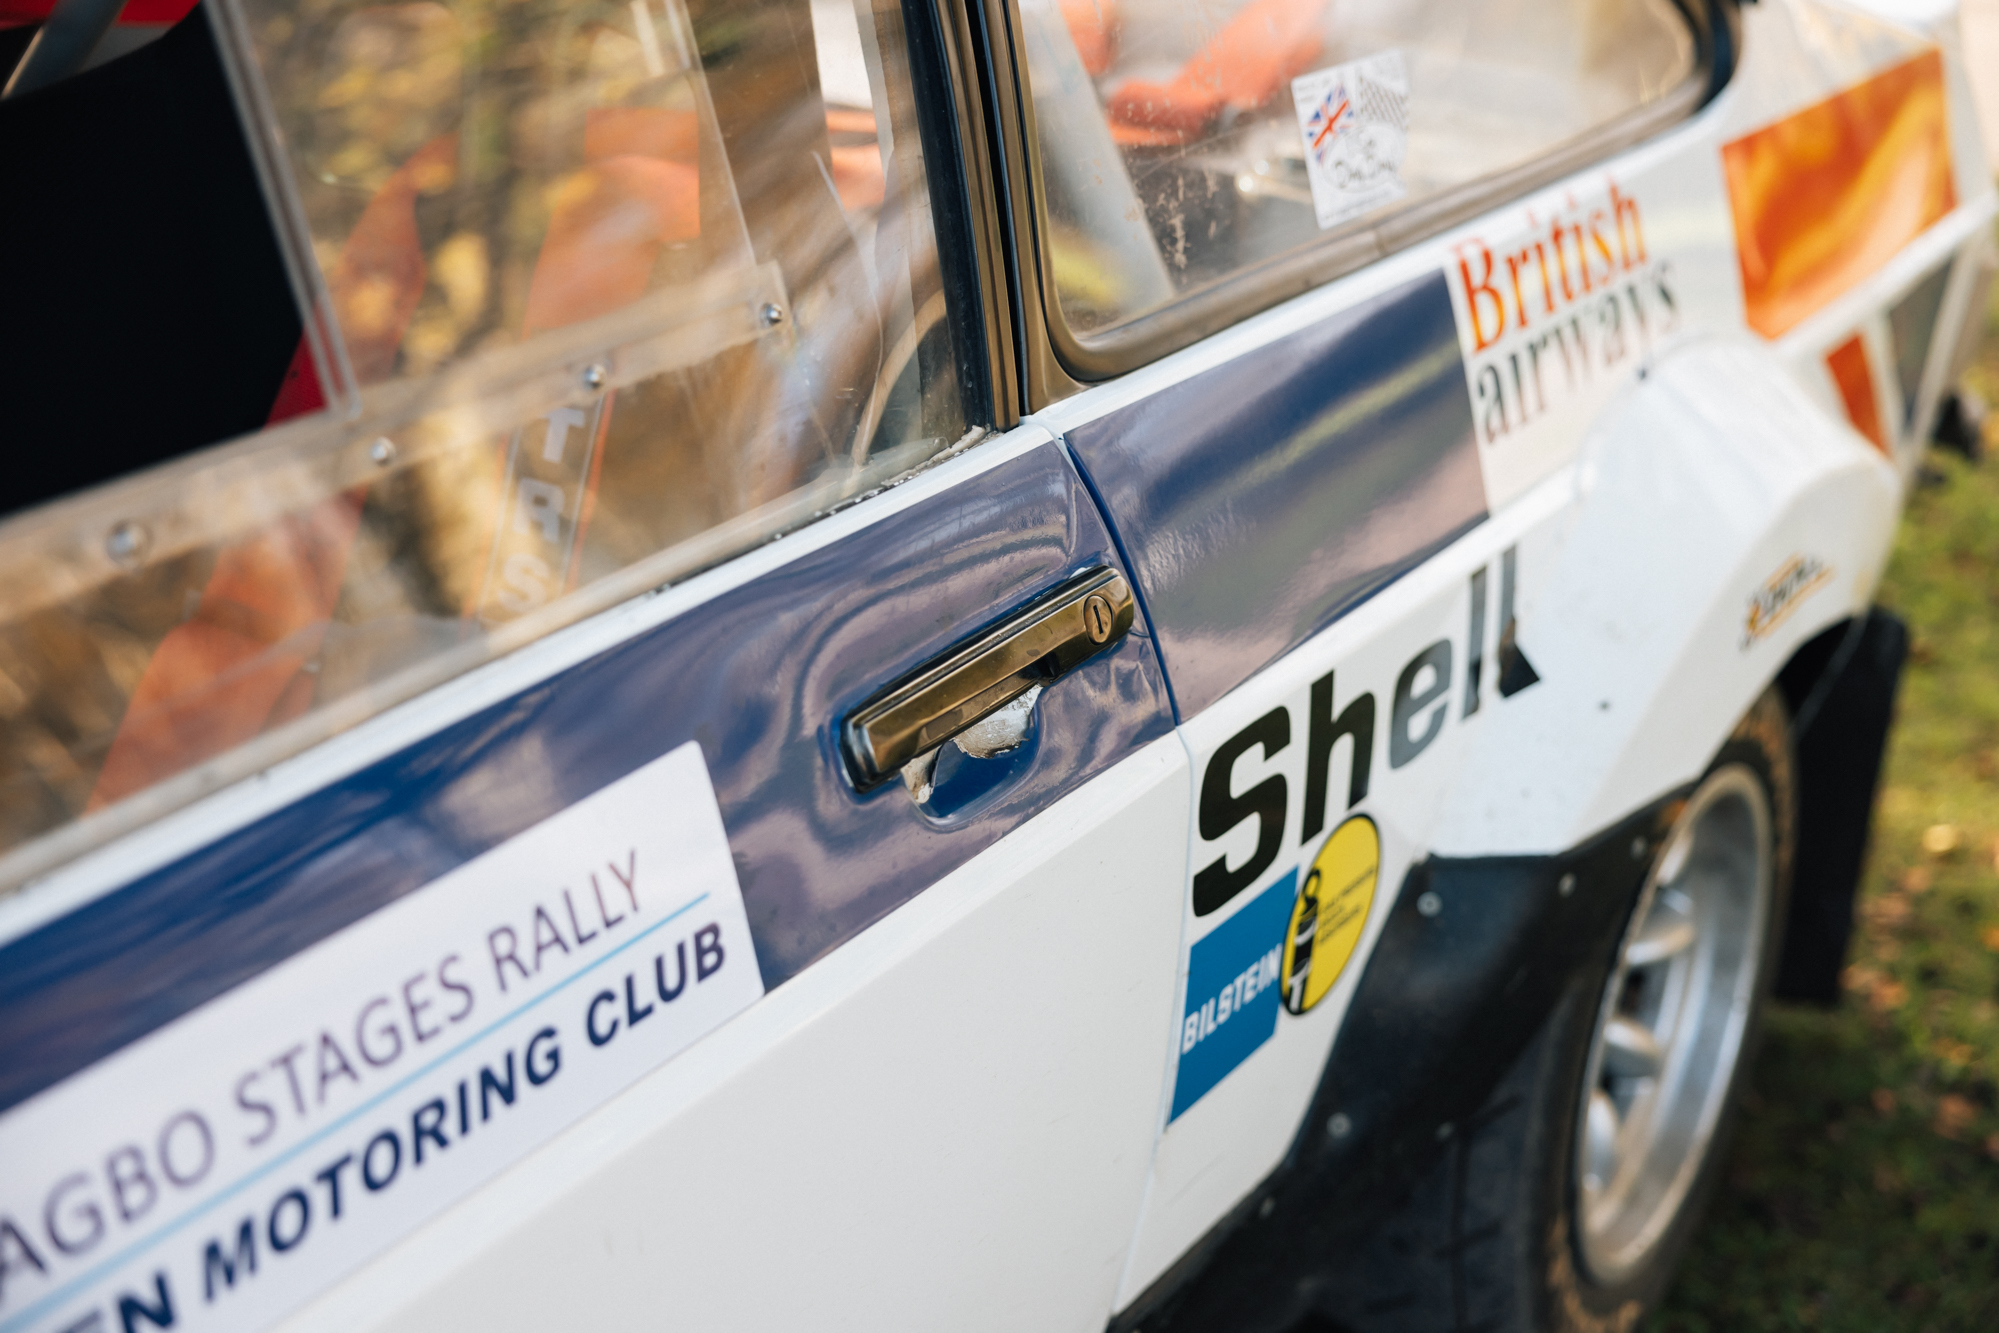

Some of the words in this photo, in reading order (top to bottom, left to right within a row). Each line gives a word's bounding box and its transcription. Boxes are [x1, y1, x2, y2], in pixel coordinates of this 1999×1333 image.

[1451, 173, 1648, 354] British
[1475, 258, 1681, 444] airways
[1192, 543, 1540, 918] Shell
[0, 1109, 215, 1298] AGBO
[233, 953, 475, 1148] STAGES
[488, 849, 639, 993] RALLY
[203, 1025, 562, 1304] MOTORING
[586, 922, 726, 1048] CLUB
[1181, 942, 1284, 1056] BILSTEIN
